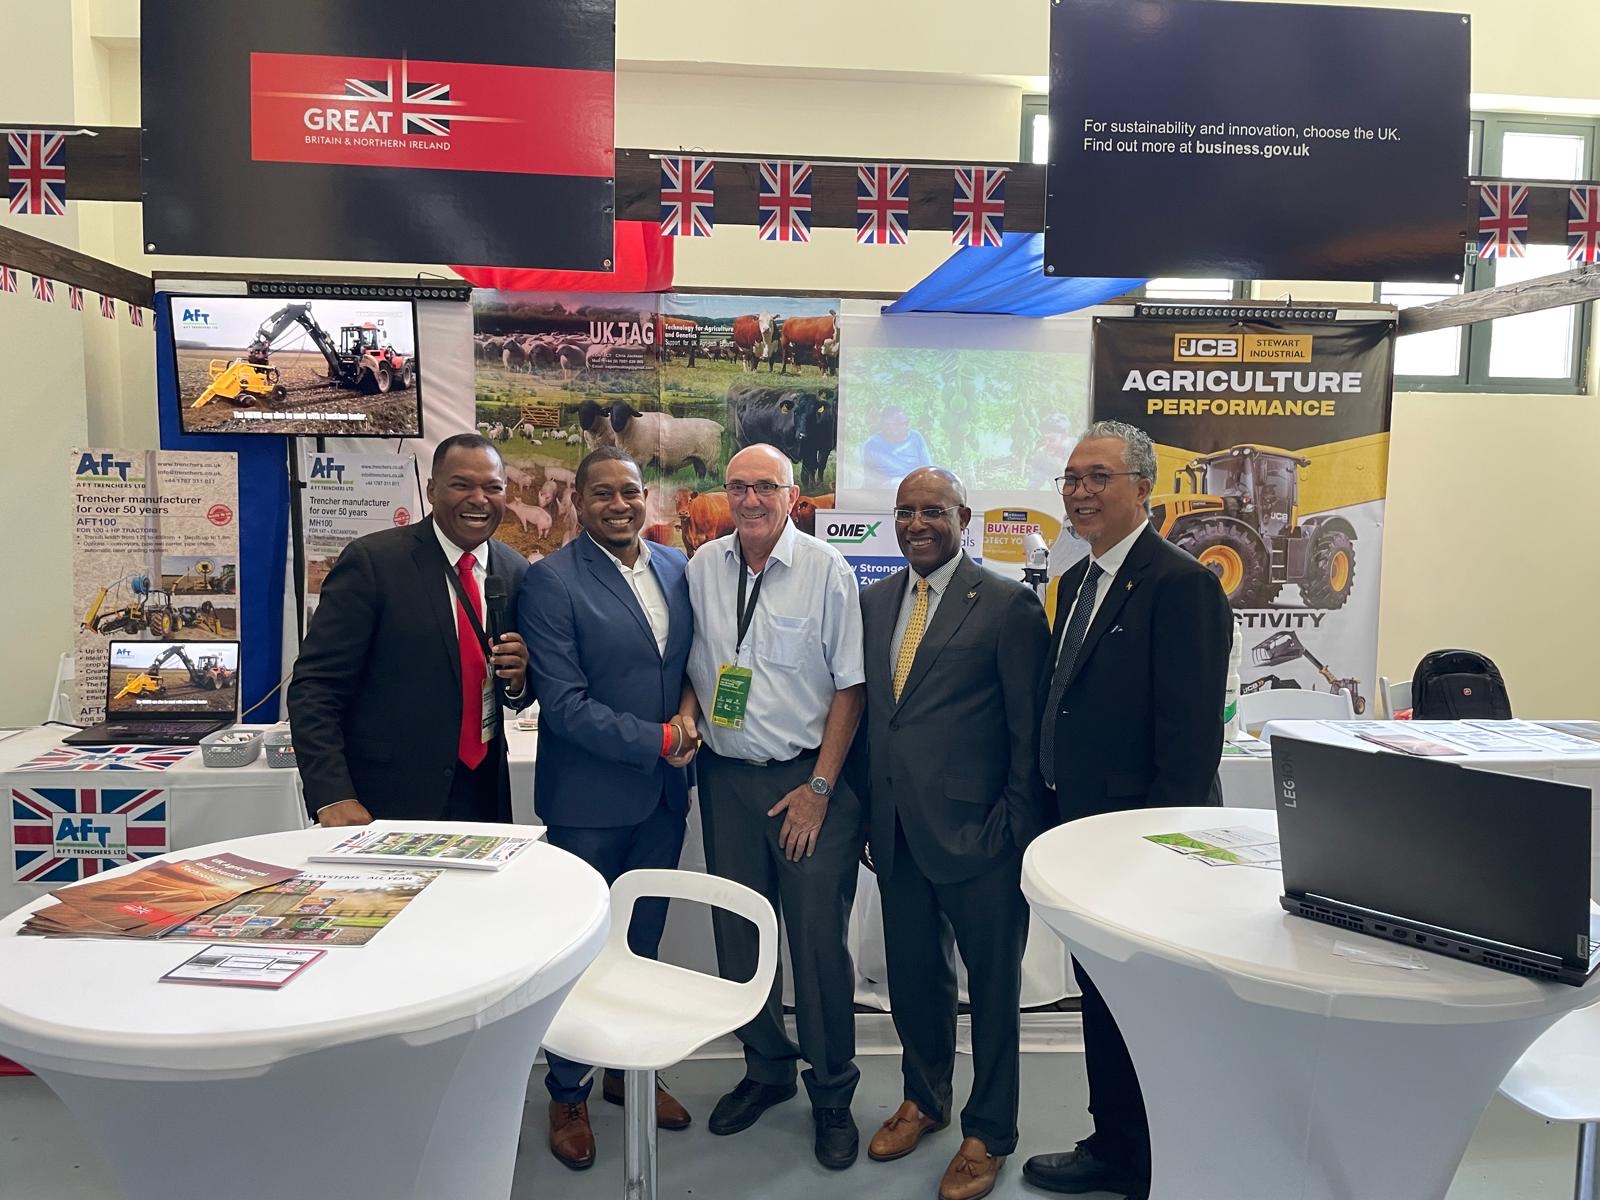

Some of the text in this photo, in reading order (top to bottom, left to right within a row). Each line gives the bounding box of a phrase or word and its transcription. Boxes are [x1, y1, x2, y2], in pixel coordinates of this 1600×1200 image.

[303, 108, 393, 134] GREAT
[1084, 119, 1401, 141] For sustainability and innovation, choose the UK.
[305, 135, 451, 151] BRITAIN & NORTHERN IRELAND
[1084, 138, 1310, 158] Find out more at business.gov.uk
[182, 309, 210, 325] AFT
[590, 321, 654, 345] UK TAG
[665, 324, 694, 333] Technology
[704, 325, 734, 333] Agriculture
[1180, 339, 1238, 356] JCB
[1256, 339, 1300, 347] STEWART
[1250, 350, 1305, 358] INDUSTRIAL
[1122, 370, 1362, 393] AGRICULTURE
[1147, 398, 1336, 416] PERFORMANCE
[76, 453, 131, 481] AFT
[311, 457, 345, 484] AFT
[76, 494, 201, 504] Trencher manufacturer
[309, 497, 390, 507] Trencher manufacturer
[76, 505, 91, 513] for
[123, 506, 136, 514] 50
[139, 507, 169, 515] years
[309, 506, 320, 514] for
[348, 508, 368, 517] years
[1270, 512, 1288, 523] JCB
[76, 518, 116, 526] AFT100
[309, 519, 333, 527] MH100
[827, 521, 882, 537] OMEX
[987, 524, 1039, 534] BUY HERE
[56, 817, 111, 848] AFT
